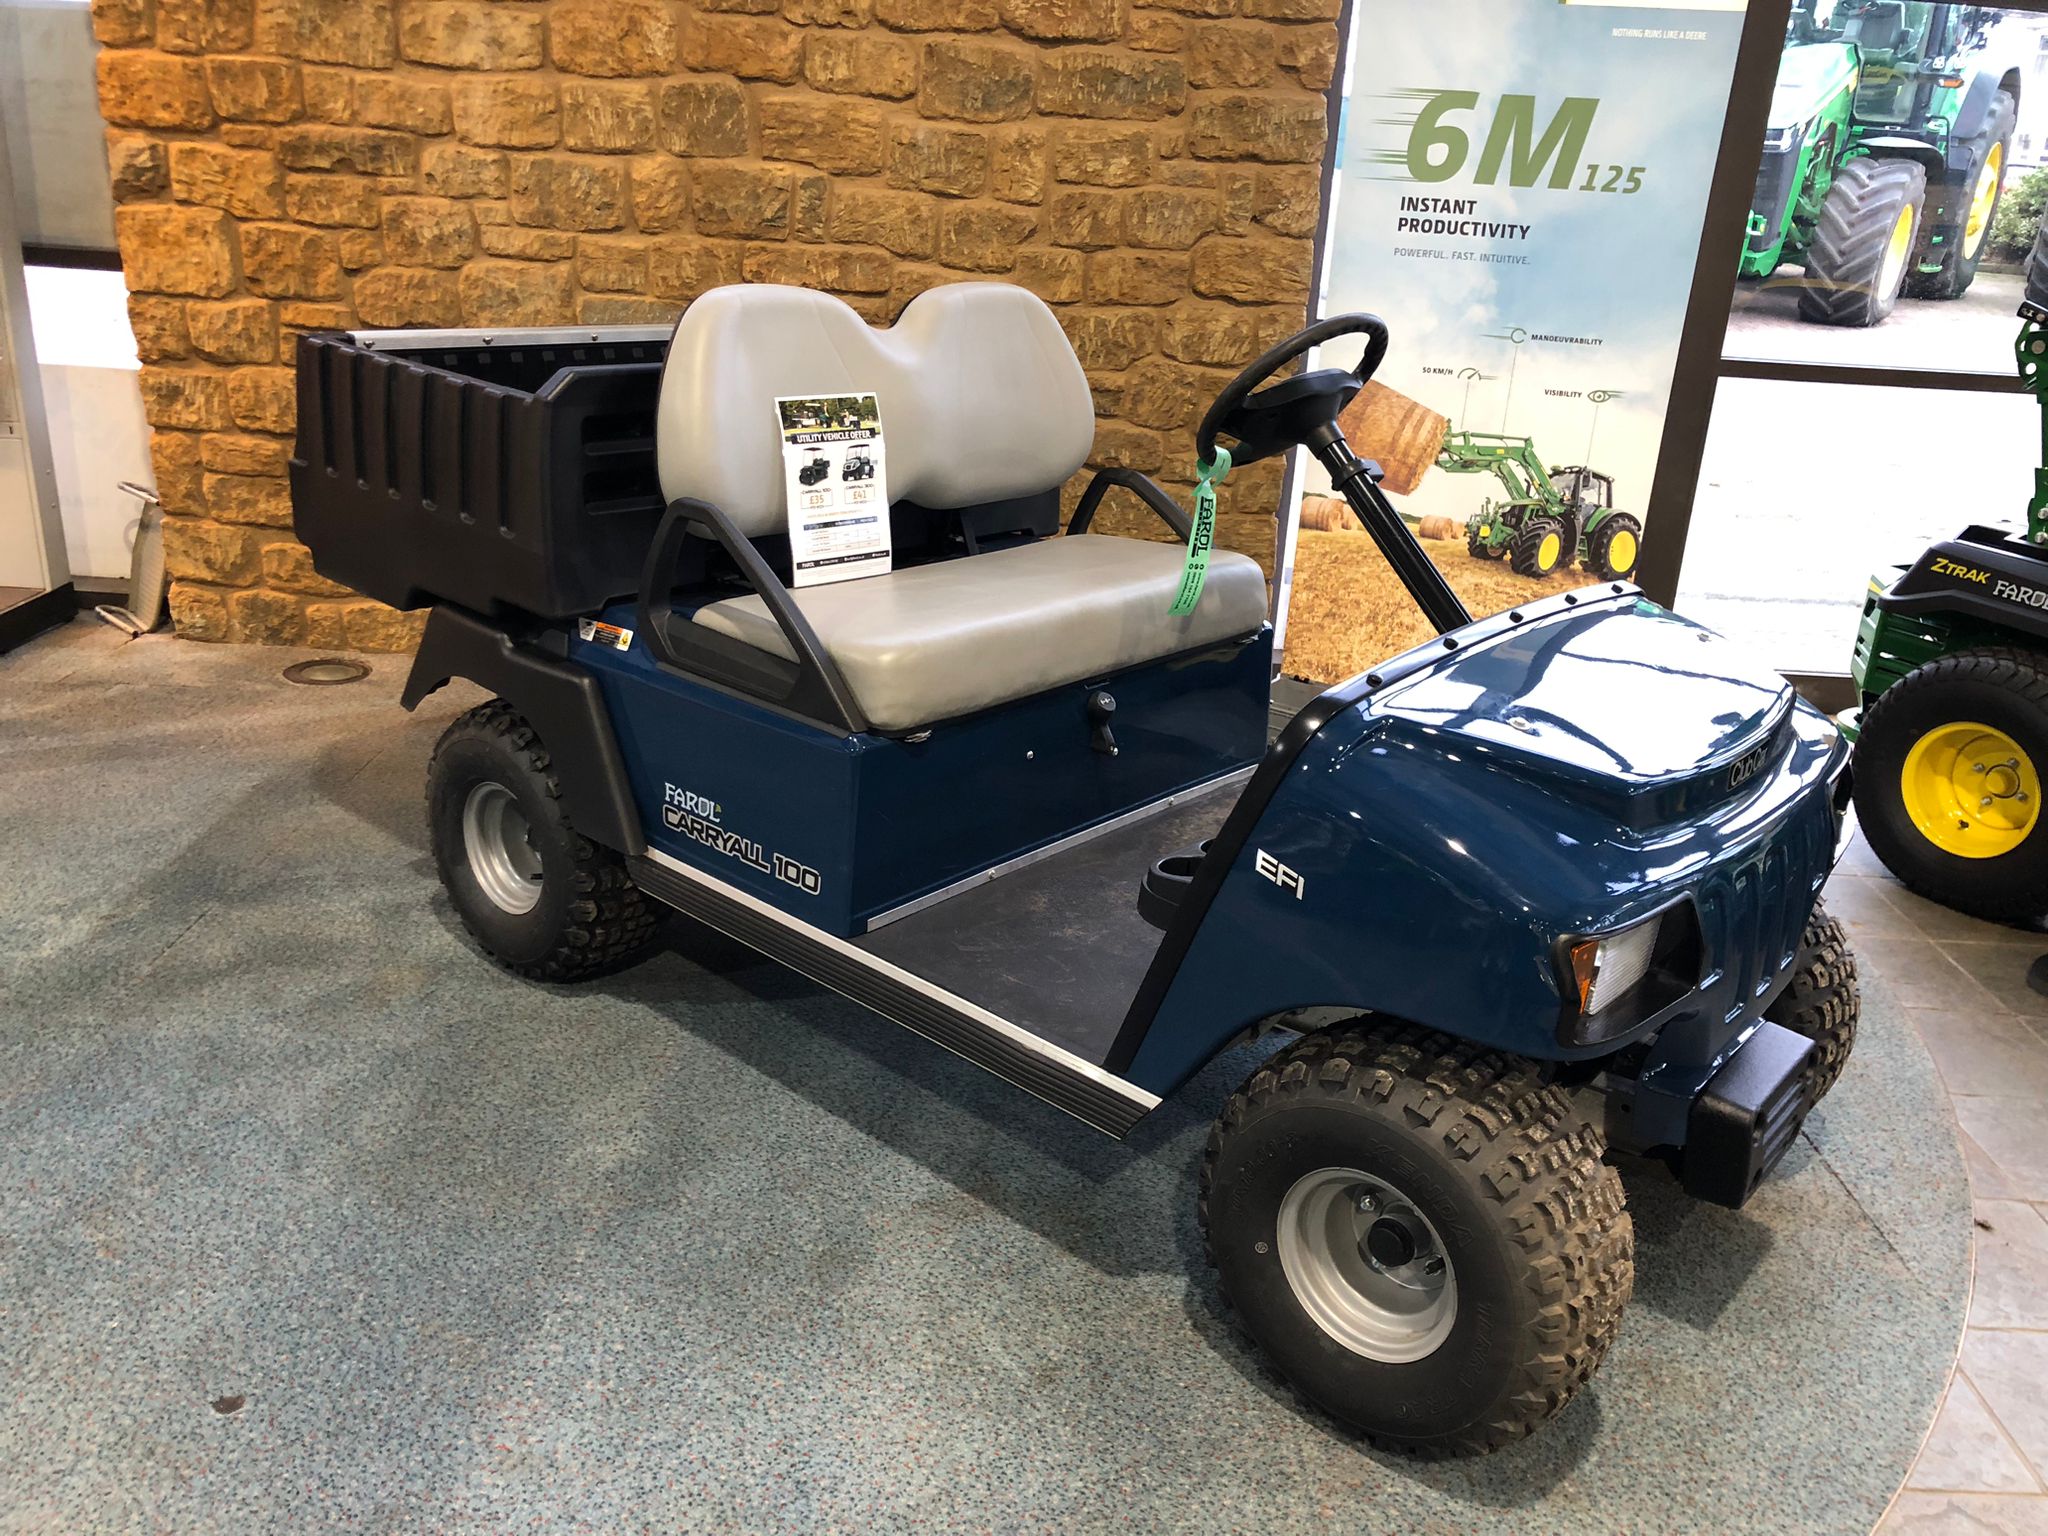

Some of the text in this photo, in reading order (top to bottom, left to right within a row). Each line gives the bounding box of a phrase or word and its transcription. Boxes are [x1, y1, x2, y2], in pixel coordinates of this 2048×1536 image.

[1612, 28, 1708, 40] NOTHING RUNS LIKE A DEERE
[1406, 88, 1647, 194] 6M 125
[1400, 196, 1478, 215] INSTANT
[1397, 217, 1531, 240] PRODUCTIVITY
[1393, 247, 1531, 265] POWERFUL. FAST. INTUITIVE.
[1531, 334, 1603, 346] MANOEUVRABILITY
[1422, 367, 1431, 375] 50
[1544, 389, 1582, 398] VISIBILITY
[797, 430, 871, 443] UTILITY VEHICLE OFFER
[809, 494, 825, 505] £35
[1195, 497, 1214, 557] FAROL
[1930, 557, 1991, 585] ZTRAK
[664, 782, 721, 823] FAROL
[662, 803, 822, 896] CARRYALL 100
[1255, 848, 1305, 901] EFI
